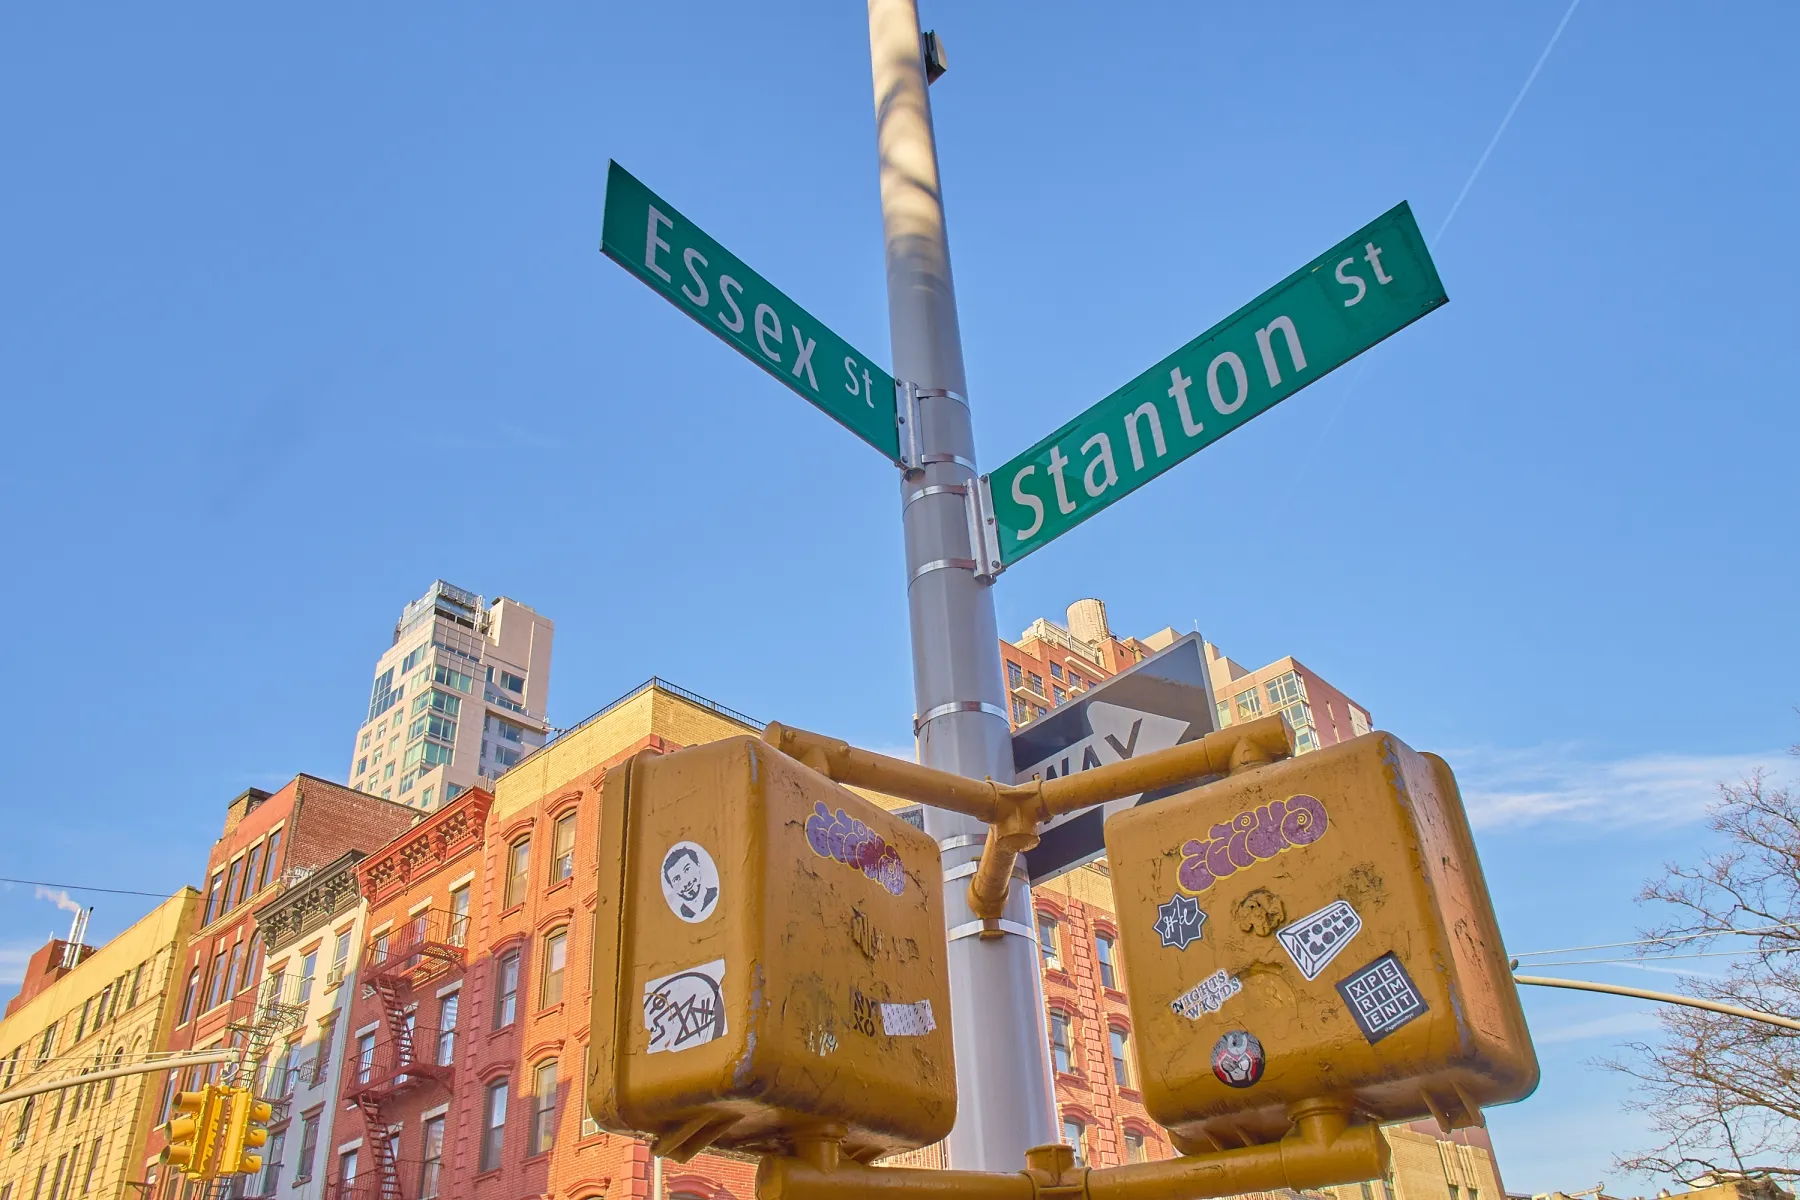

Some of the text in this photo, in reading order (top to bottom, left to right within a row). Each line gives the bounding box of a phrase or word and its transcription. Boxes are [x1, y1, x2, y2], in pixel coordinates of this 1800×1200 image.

[645, 204, 875, 408] Essex St
[1011, 241, 1393, 541] Stanton St
[1309, 916, 1354, 955] GOLD
[1172, 971, 1226, 1013] NIGHTS
[1186, 978, 1240, 1019] WKNDS
